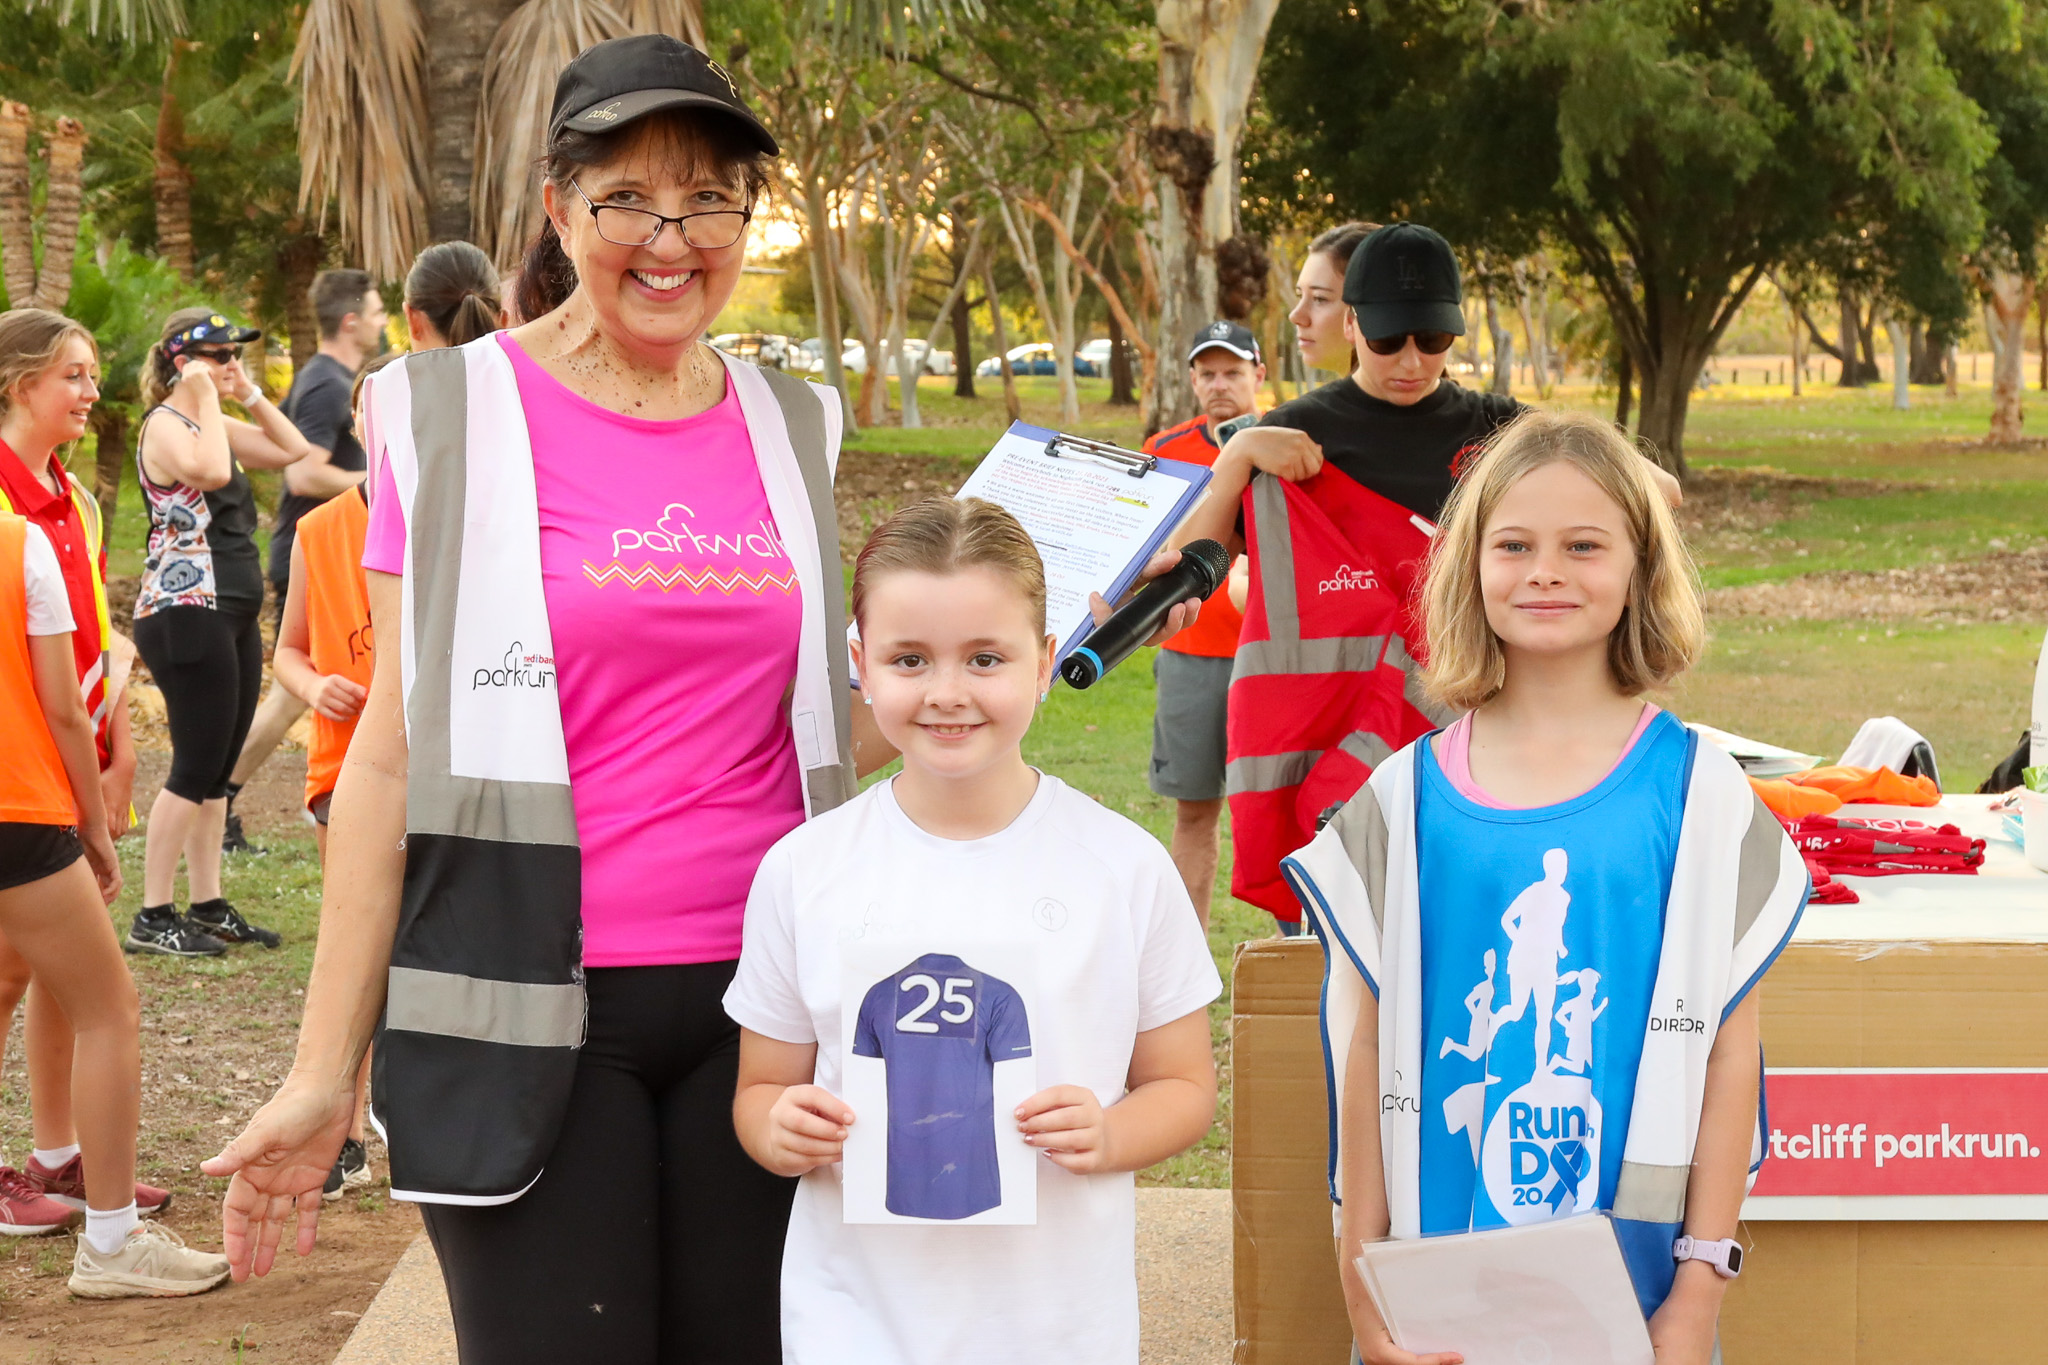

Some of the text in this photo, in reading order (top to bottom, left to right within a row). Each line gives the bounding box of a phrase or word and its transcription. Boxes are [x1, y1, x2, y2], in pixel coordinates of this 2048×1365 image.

[1319, 568, 1379, 595] parkrun
[473, 647, 556, 690] parkrun
[896, 974, 975, 1034] 25
[1508, 1101, 1586, 1140] Run
[1766, 1122, 2041, 1168] tcliff parkrun.
